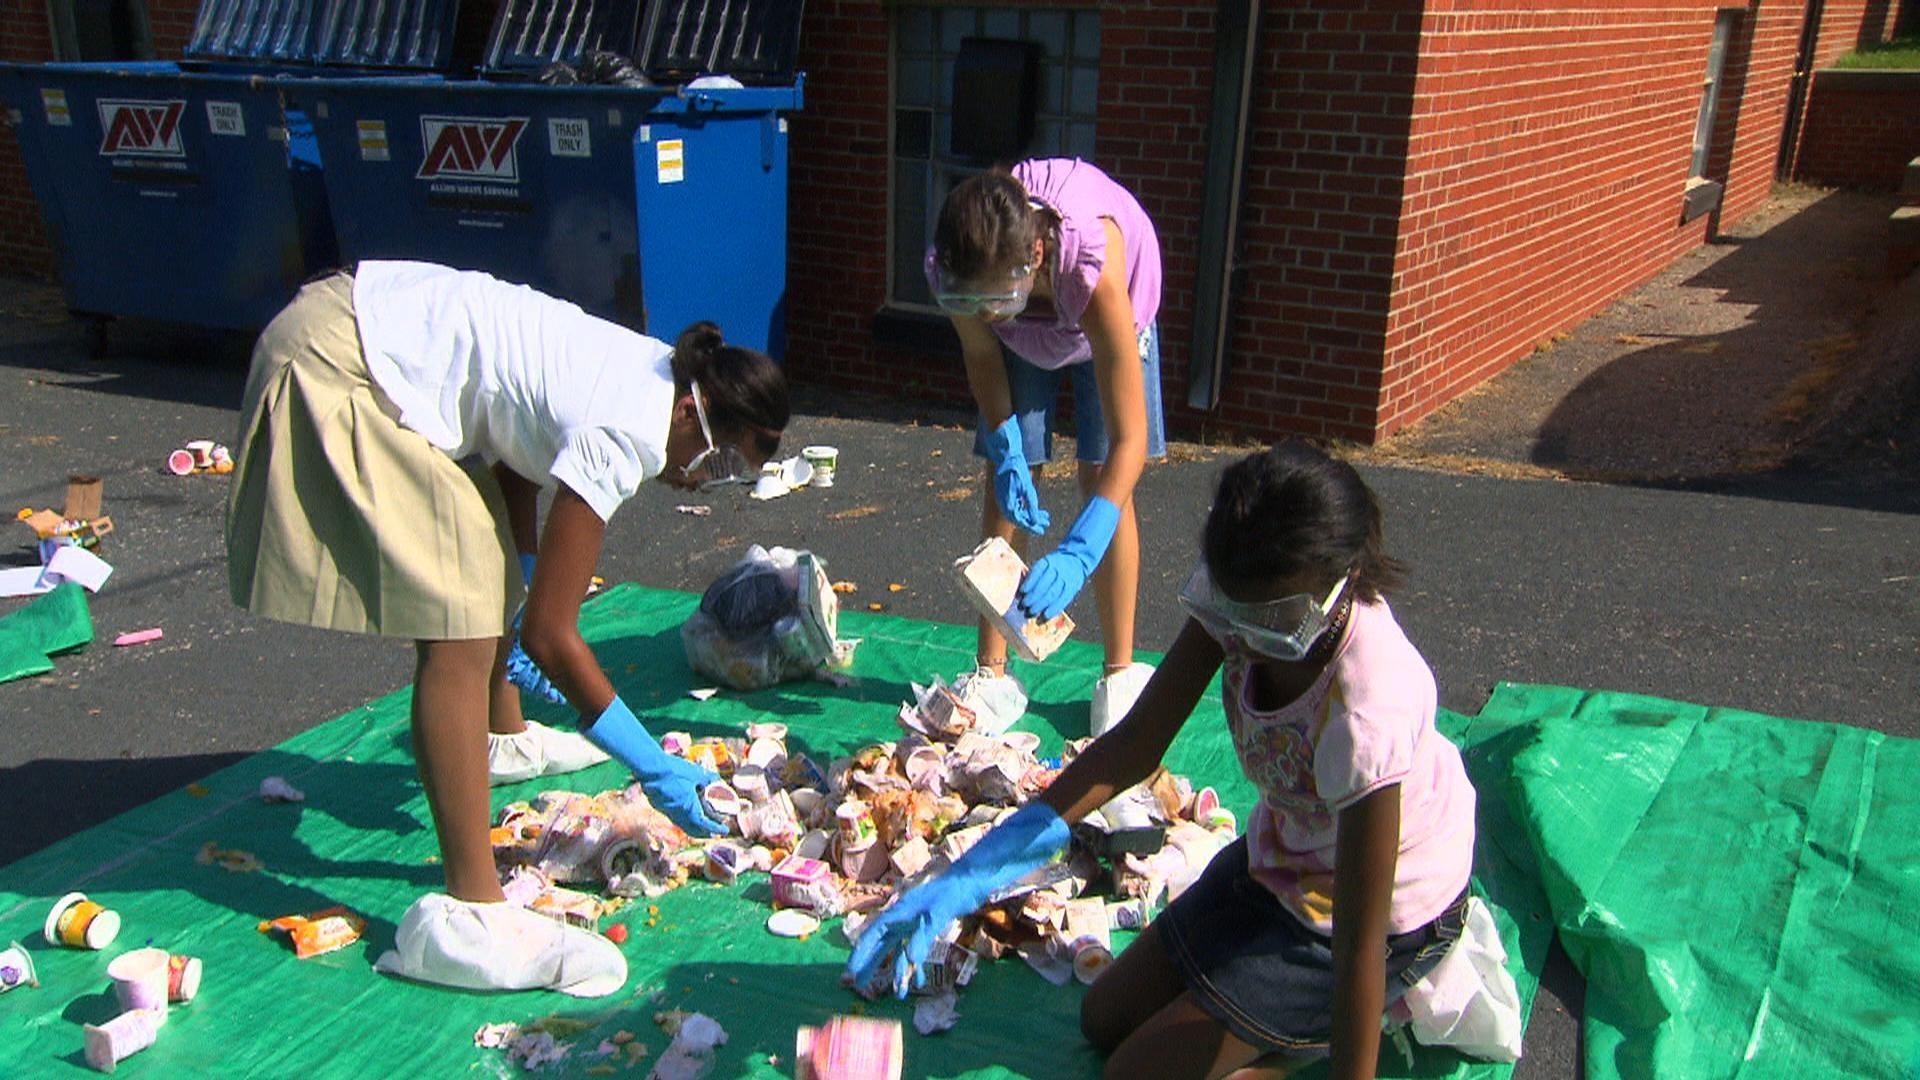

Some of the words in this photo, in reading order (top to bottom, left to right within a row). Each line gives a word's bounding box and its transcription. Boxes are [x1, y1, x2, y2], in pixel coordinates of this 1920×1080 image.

[211, 105, 238, 117] TRASH
[216, 118, 237, 131] ONLY
[555, 123, 584, 137] TRASH
[558, 137, 581, 151] ONLY
